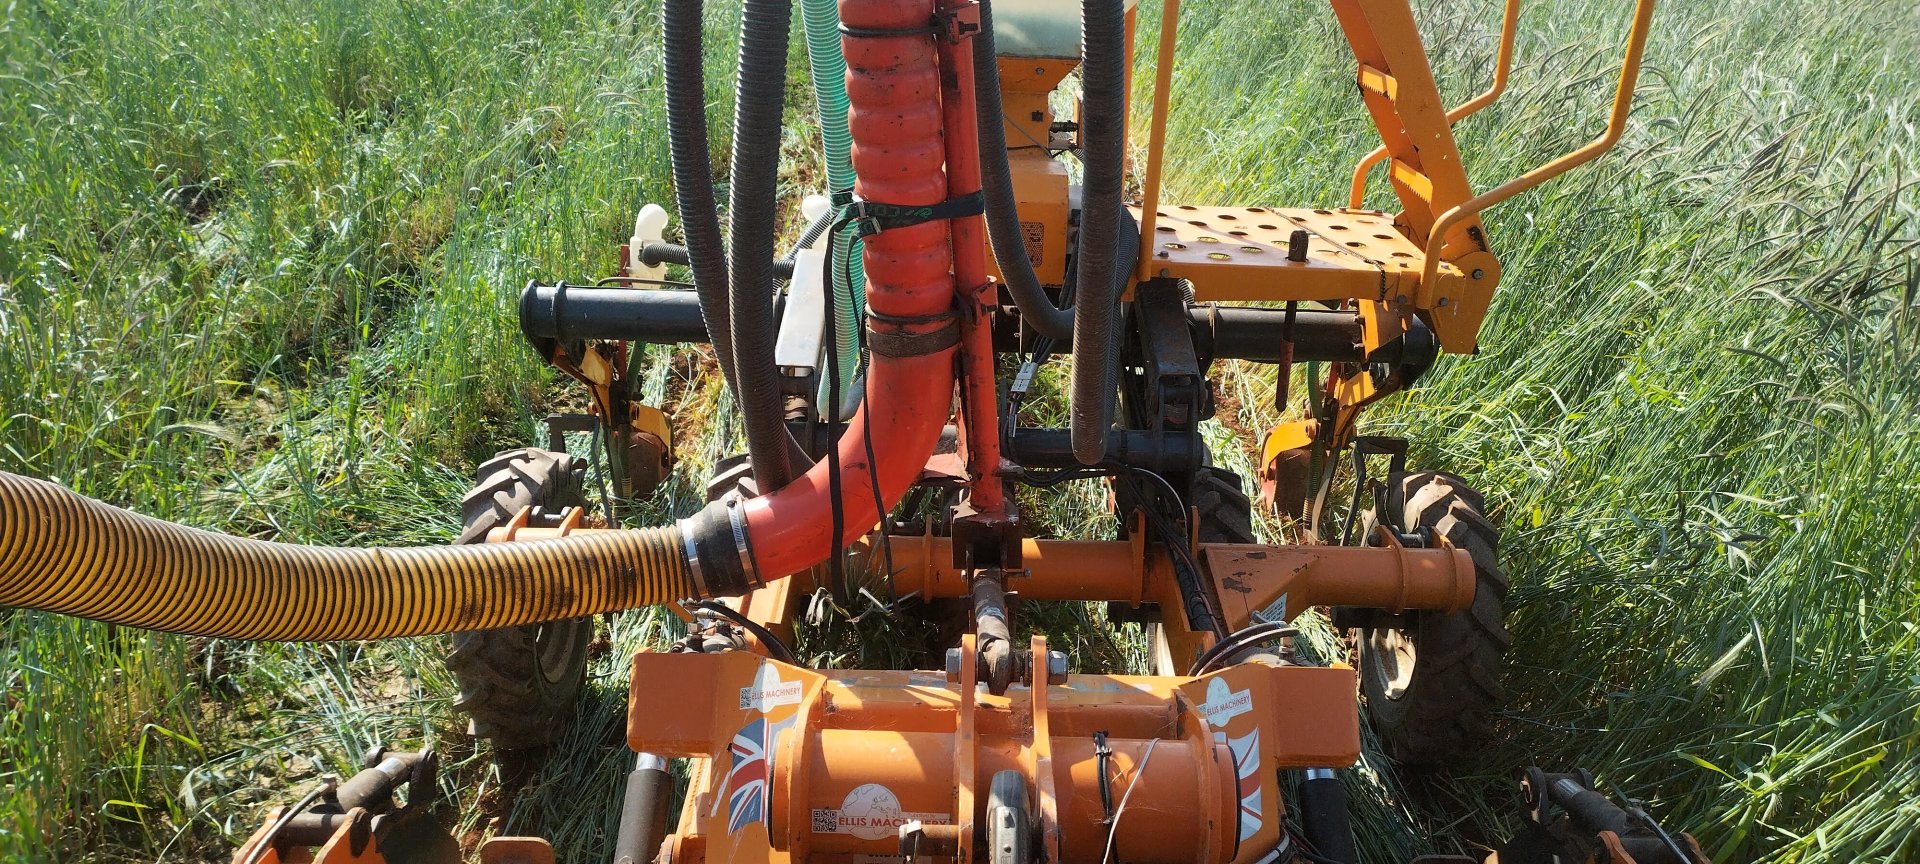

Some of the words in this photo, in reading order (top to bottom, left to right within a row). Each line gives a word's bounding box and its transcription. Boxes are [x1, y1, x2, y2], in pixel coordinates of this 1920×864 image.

[765, 687, 800, 698] MACHINERY
[1207, 704, 1219, 716] ELLIS
[1220, 695, 1249, 712] MACHINERY
[838, 816, 867, 826] ELLIS
[870, 817, 947, 828] MACERY
